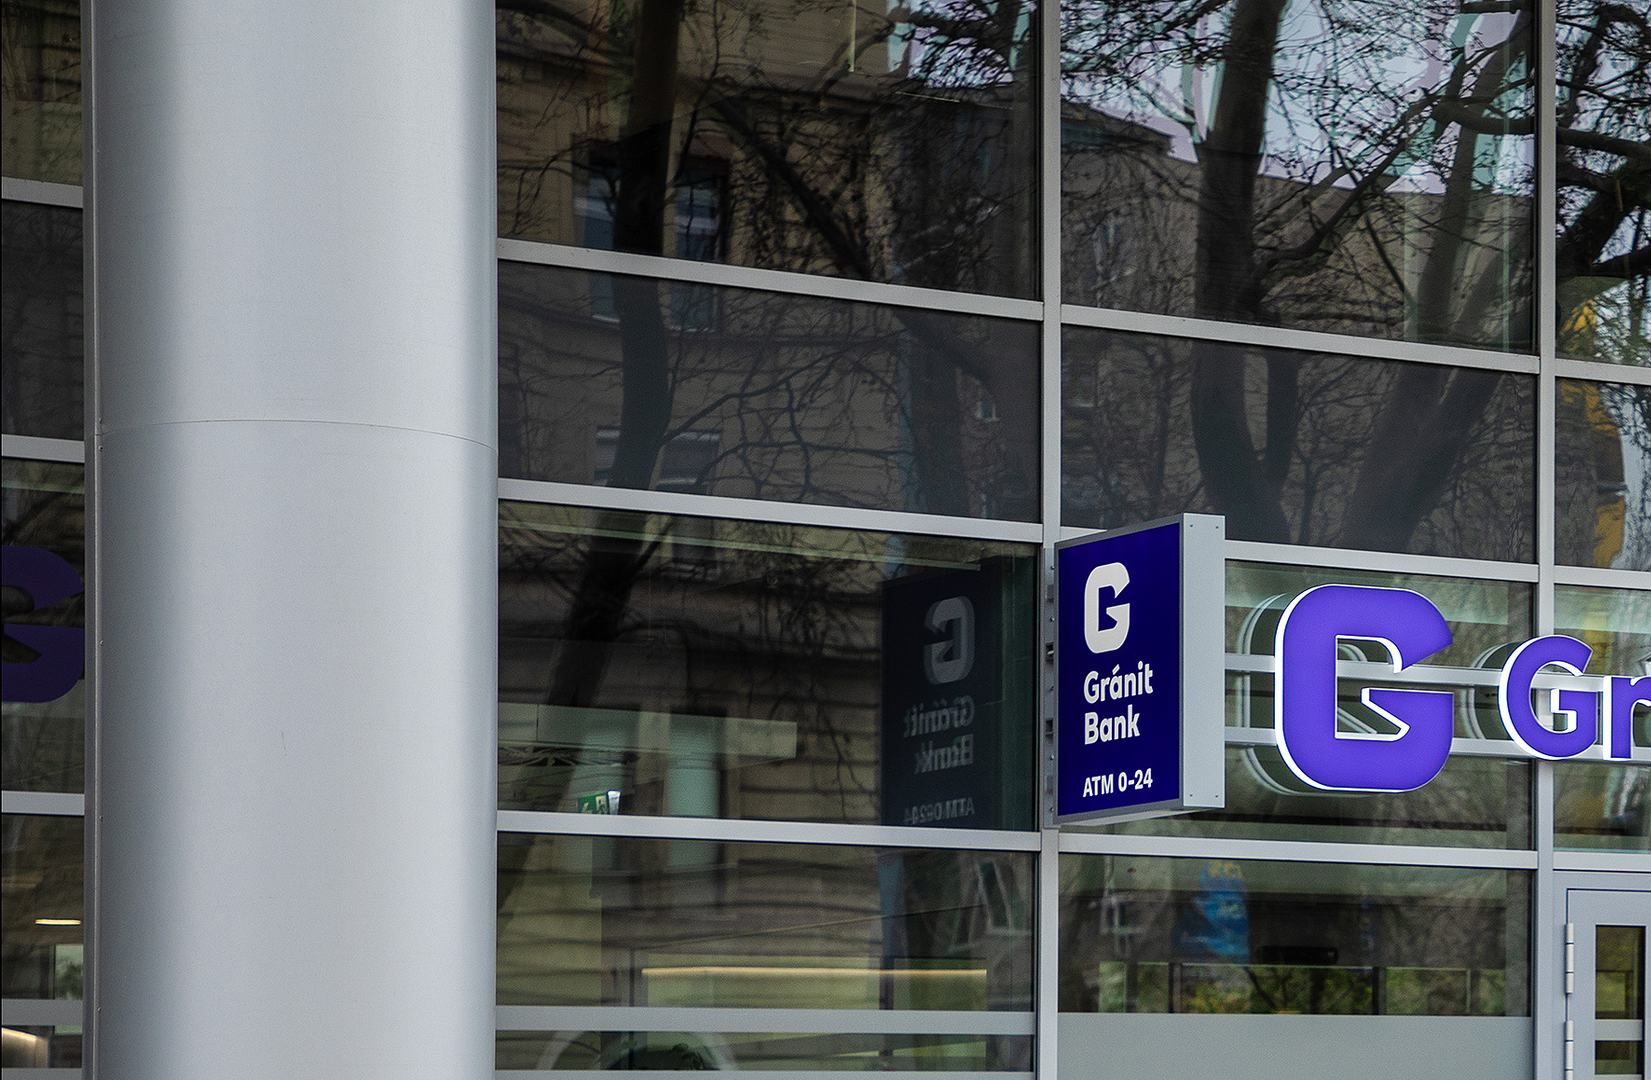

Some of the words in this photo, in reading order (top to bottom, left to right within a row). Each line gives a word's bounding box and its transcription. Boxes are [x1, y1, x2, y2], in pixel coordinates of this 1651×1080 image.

[1084, 561, 1131, 654] G
[1083, 660, 1154, 704] Gránit
[1274, 583, 1454, 793] G
[1084, 704, 1141, 745] Bank
[1083, 773, 1114, 797] ATM
[1118, 768, 1153, 793] 0-24
